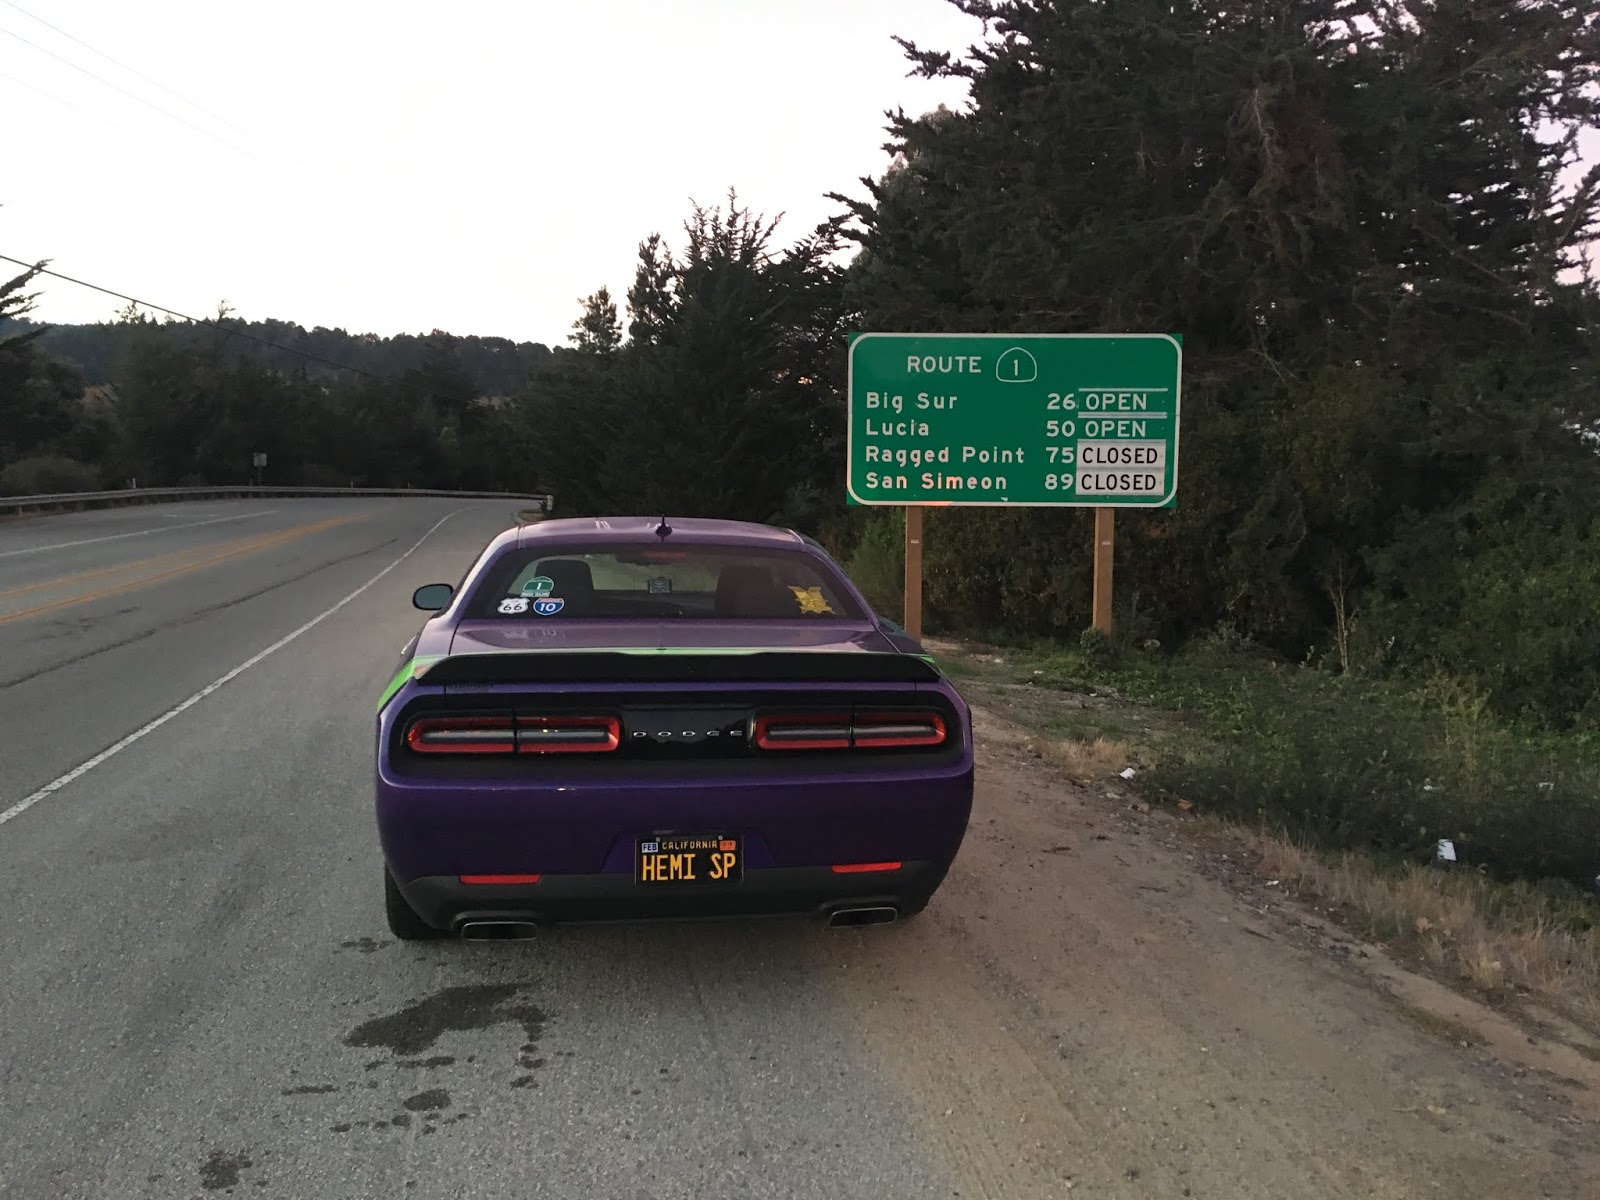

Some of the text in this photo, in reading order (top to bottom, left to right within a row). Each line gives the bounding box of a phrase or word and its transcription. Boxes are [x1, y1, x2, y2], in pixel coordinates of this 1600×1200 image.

[906, 355, 1019, 376] ROUTE 1
[866, 391, 1147, 414] Big Sur 26 OPEN
[866, 418, 1146, 437] Lucia 50 OPEN
[865, 445, 1158, 468] Ragged Point 75 CLOSED
[865, 472, 1156, 490] San Simeon 89 CLOSED
[503, 603, 523, 611] 66
[540, 603, 557, 612] 10
[633, 730, 743, 738] DODGE
[642, 843, 657, 851] FEB
[661, 840, 718, 850] CALIFORNIA
[642, 852, 736, 881] HEMI SP
